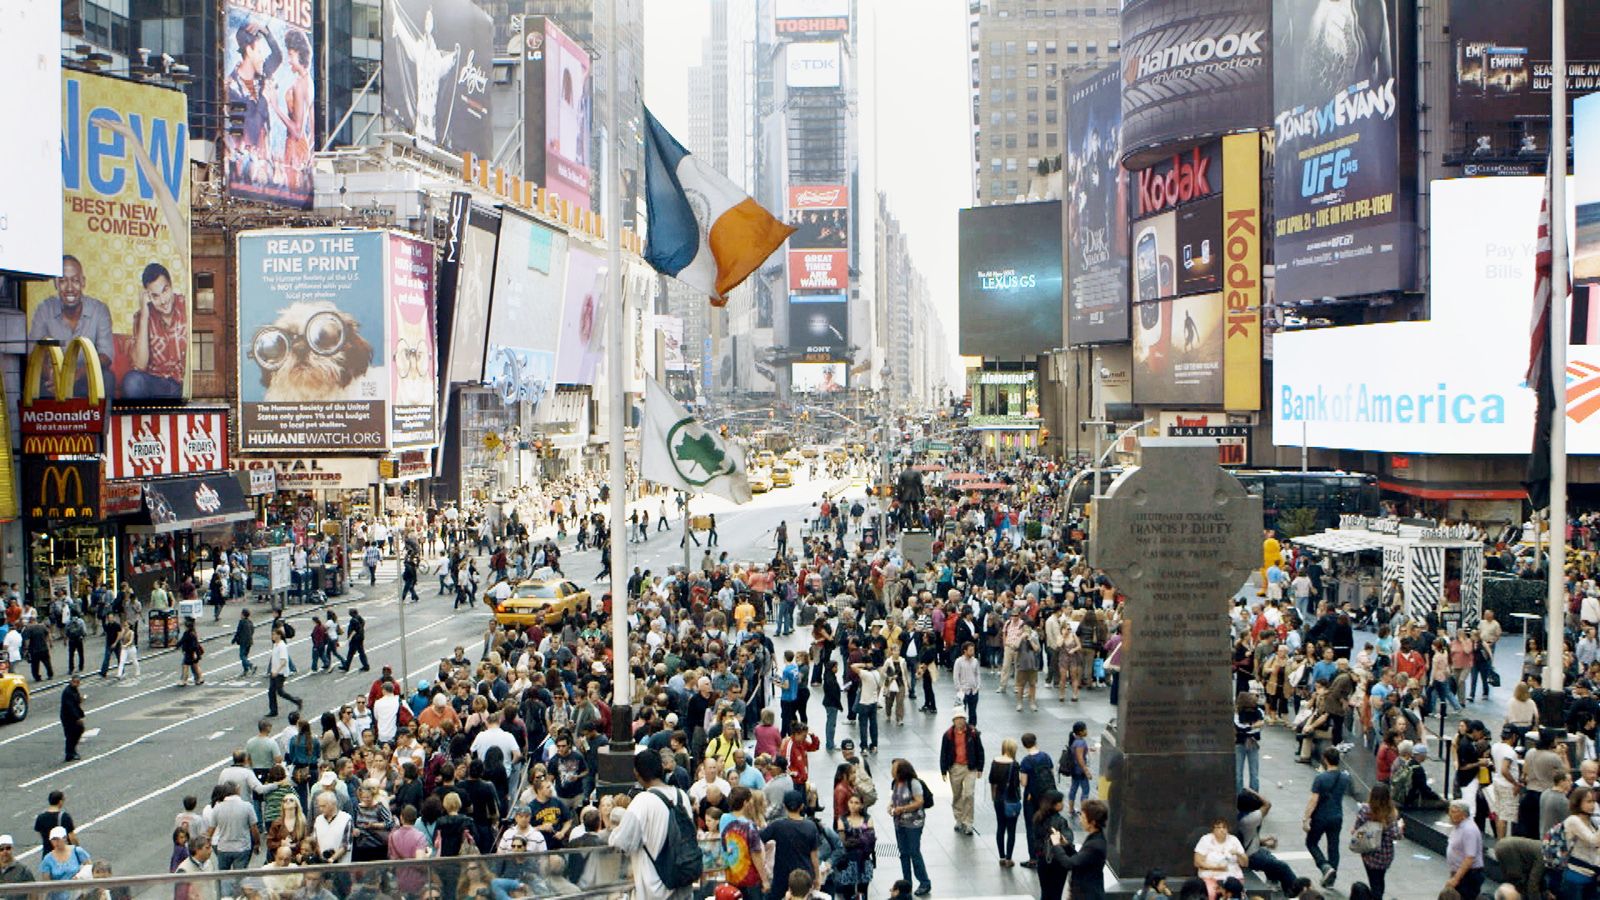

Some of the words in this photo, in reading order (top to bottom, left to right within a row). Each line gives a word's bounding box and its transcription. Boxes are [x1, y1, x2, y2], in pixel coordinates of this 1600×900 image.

[777, 18, 847, 32] TOSHIBA
[528, 52, 541, 60] LG
[800, 60, 834, 69] TDK
[1151, 65, 1192, 85] driving
[1194, 56, 1262, 74] emotion
[1569, 64, 1586, 76] ONE
[1575, 77, 1593, 89] DVD
[1275, 107, 1318, 147] JONES
[1335, 78, 1395, 126] EVANS
[1302, 148, 1352, 198] UFC
[1138, 148, 1213, 216] Kodak
[120, 203, 158, 222] NEW
[267, 239, 315, 255] READ
[319, 238, 354, 253] THE
[262, 258, 303, 273] FINE
[308, 256, 360, 272] PRINT
[804, 255, 833, 263] GREAT
[1227, 208, 1256, 339] Kodak
[1485, 265, 1522, 279] Bills
[983, 276, 1018, 289] LEXUS
[1020, 275, 1035, 288] GS
[300, 404, 323, 412] Society
[1281, 385, 1328, 421] Bank
[1355, 383, 1505, 424] America
[23, 410, 100, 422] McDonald's
[345, 412, 370, 420] budget
[36, 423, 87, 431] Restaurant
[1174, 427, 1248, 436] MARQUIS
[248, 432, 381, 445] HUMANEWATCH.ORG
[276, 472, 342, 481] COMPUTERS
[1130, 522, 1177, 534] FRANCIS
[1192, 522, 1233, 534] DUFFY
